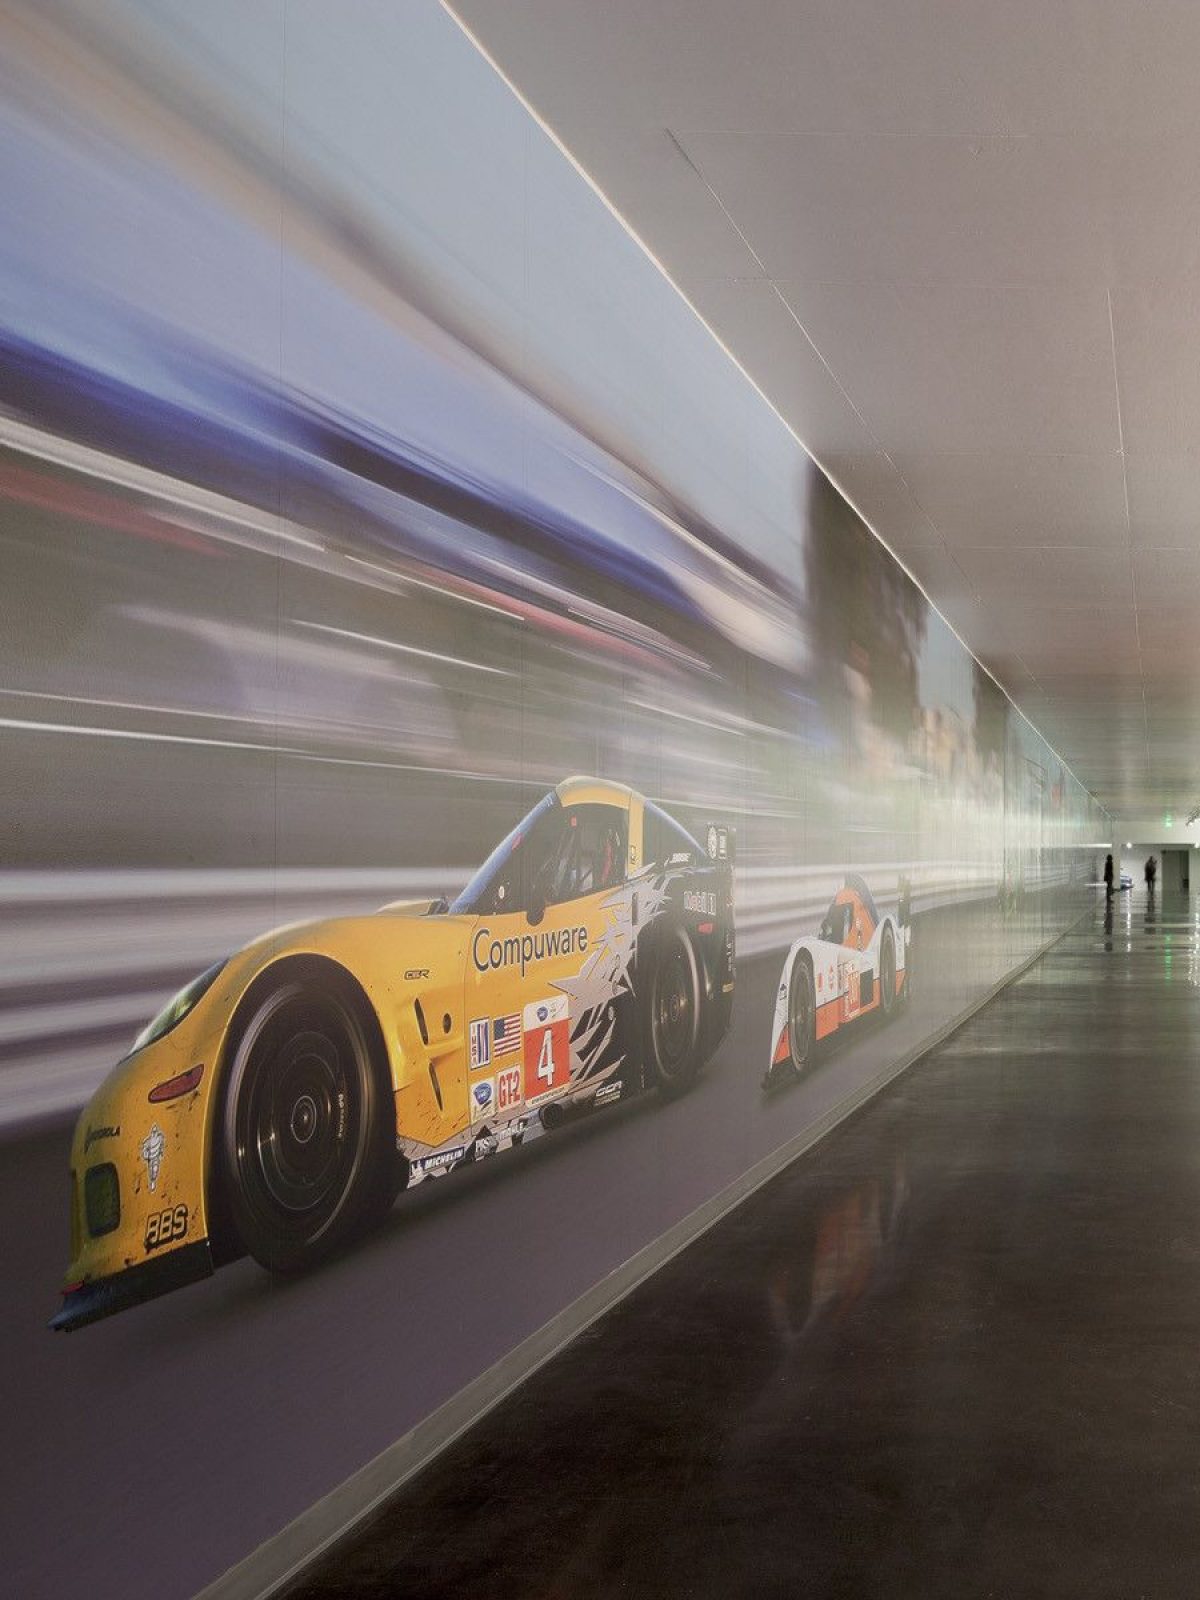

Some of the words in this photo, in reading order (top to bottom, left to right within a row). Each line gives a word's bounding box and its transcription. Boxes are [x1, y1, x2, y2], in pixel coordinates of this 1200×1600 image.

[473, 926, 587, 977] Compuware
[537, 1028, 556, 1087] 4
[424, 1147, 463, 1170] MICHELIN
[145, 1204, 189, 1253] BBS
